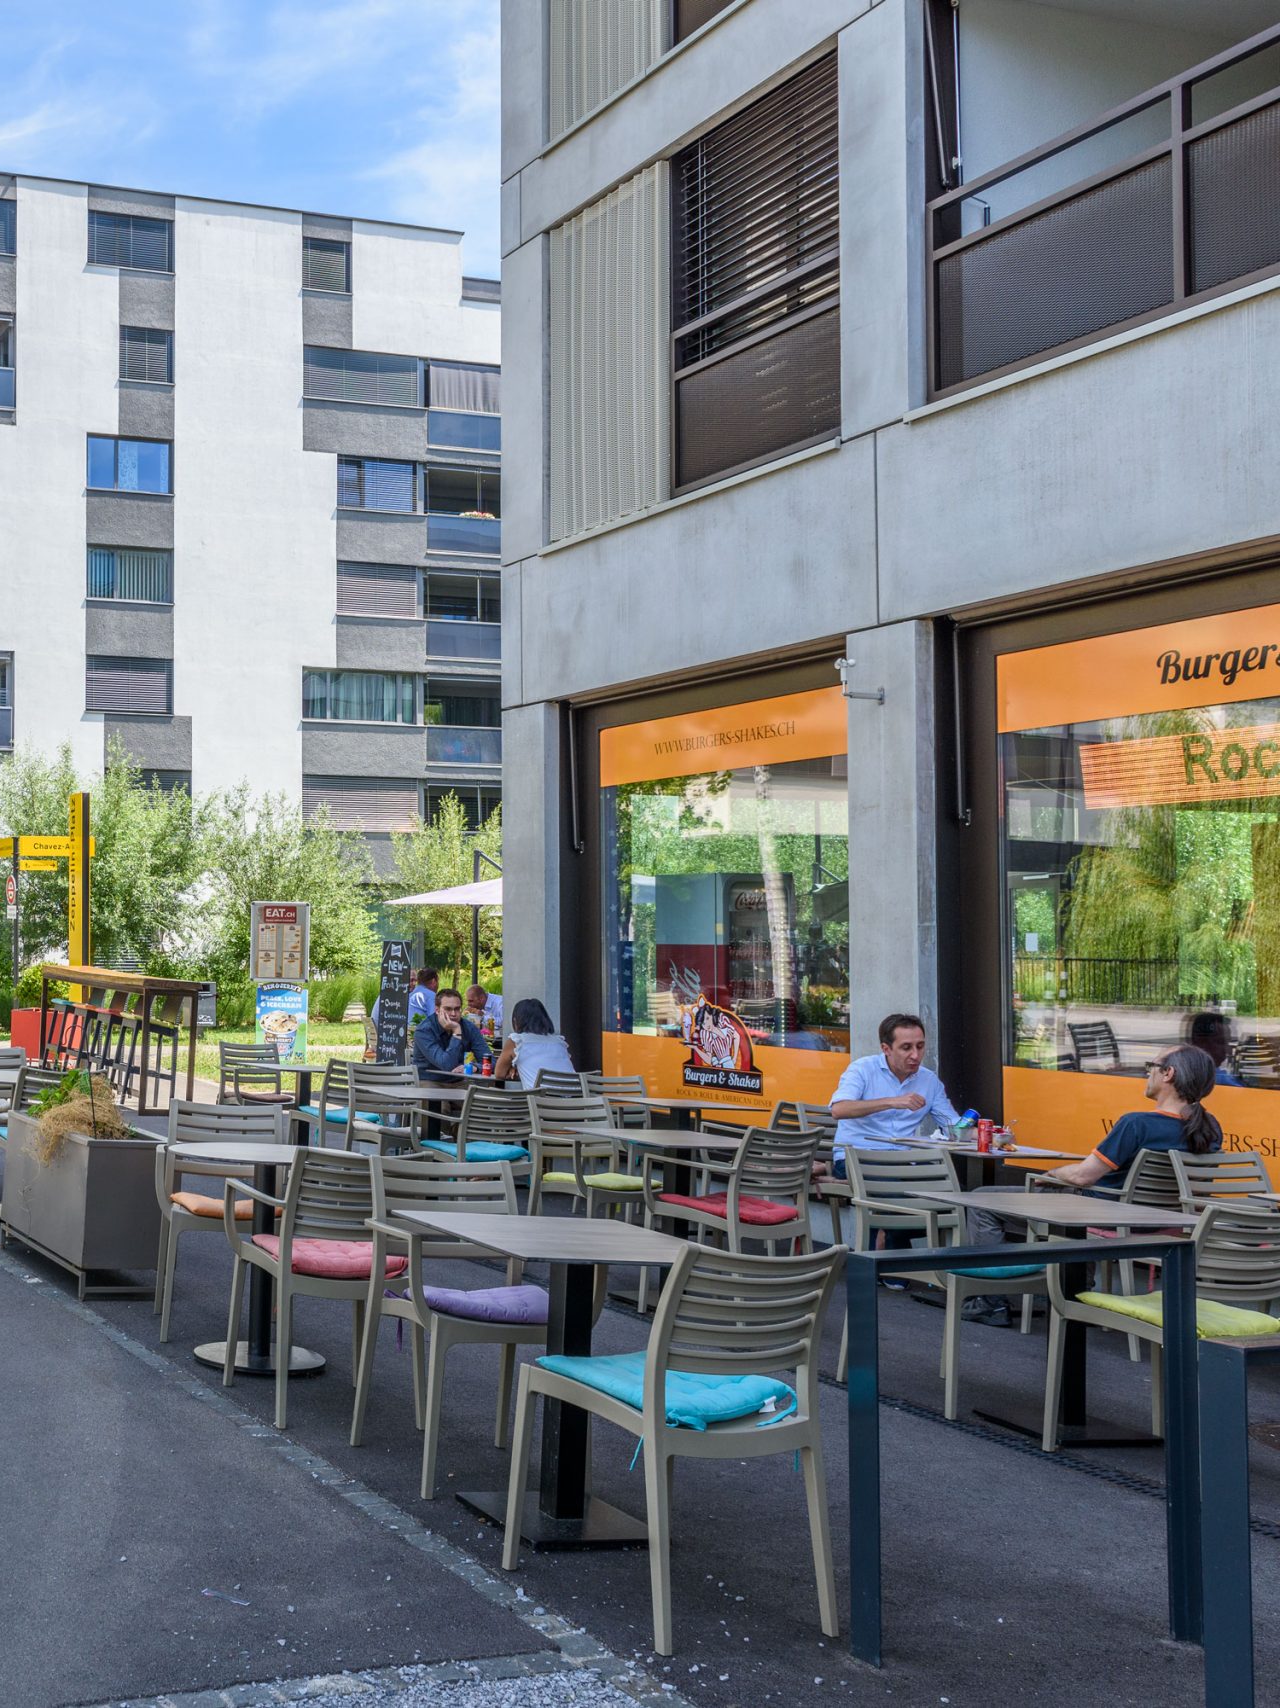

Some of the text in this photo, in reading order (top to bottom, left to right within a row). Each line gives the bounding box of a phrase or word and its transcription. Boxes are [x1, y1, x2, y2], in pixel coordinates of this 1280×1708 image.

[654, 720, 796, 756] WWW.BURGERS-SHAKES.CH
[33, 842, 70, 850] Chavez-A
[388, 959, 404, 971] NEW
[684, 1068, 760, 1089] Burgers & Shakes
